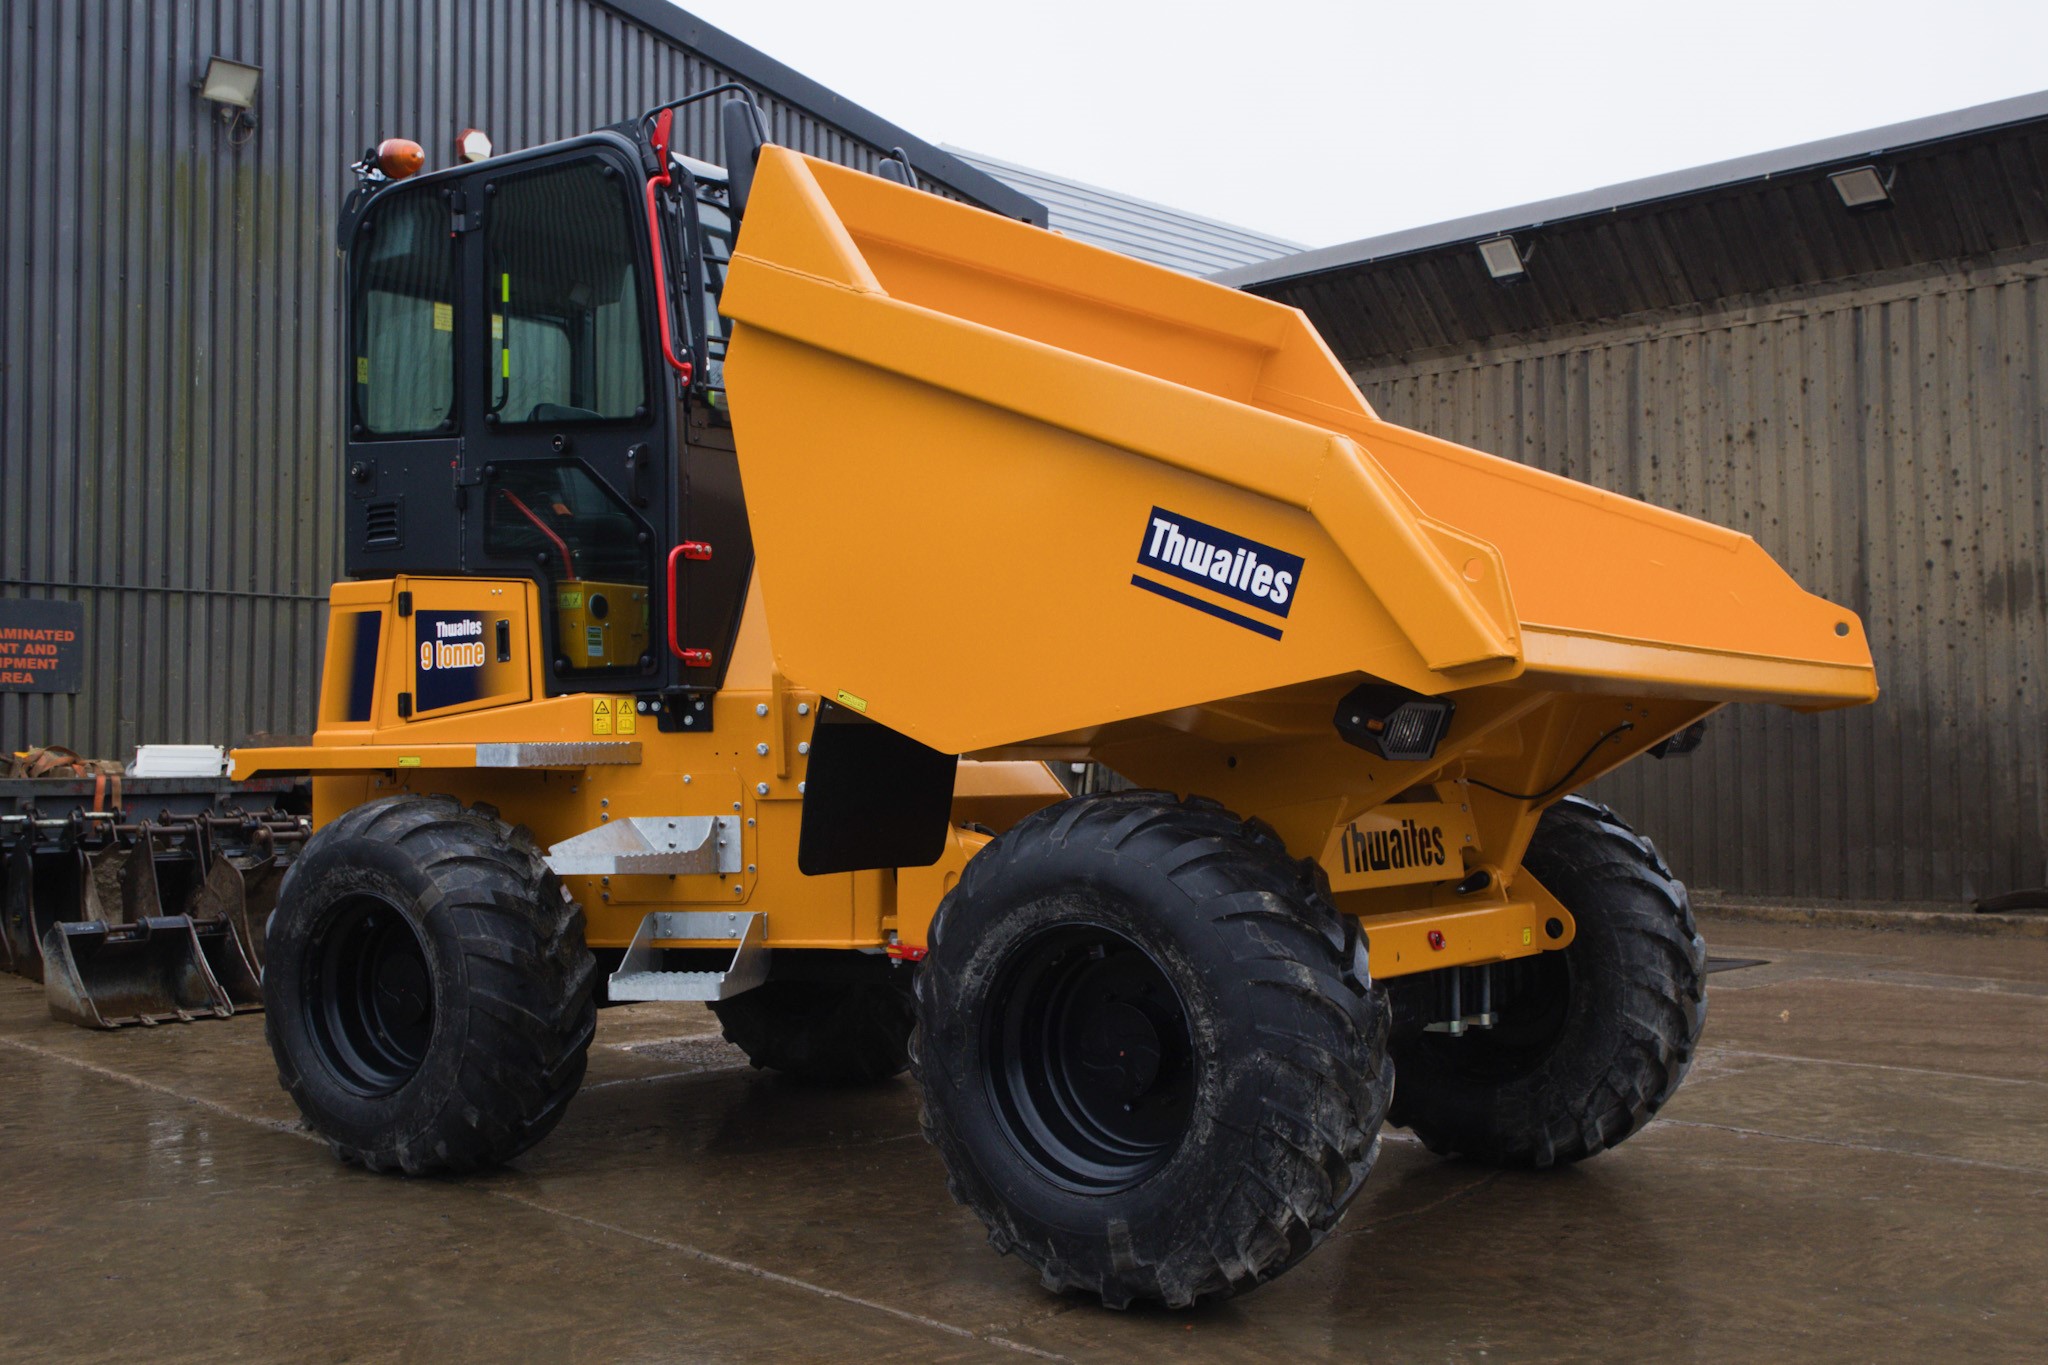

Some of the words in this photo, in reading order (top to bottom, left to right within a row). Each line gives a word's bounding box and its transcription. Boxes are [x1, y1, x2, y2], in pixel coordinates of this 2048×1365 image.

[1149, 517, 1293, 604] Thwaites
[436, 619, 482, 638] Thwaites
[24, 644, 57, 655] AND
[421, 641, 433, 671] 9
[436, 640, 485, 669] tonne
[0, 672, 34, 683] REA
